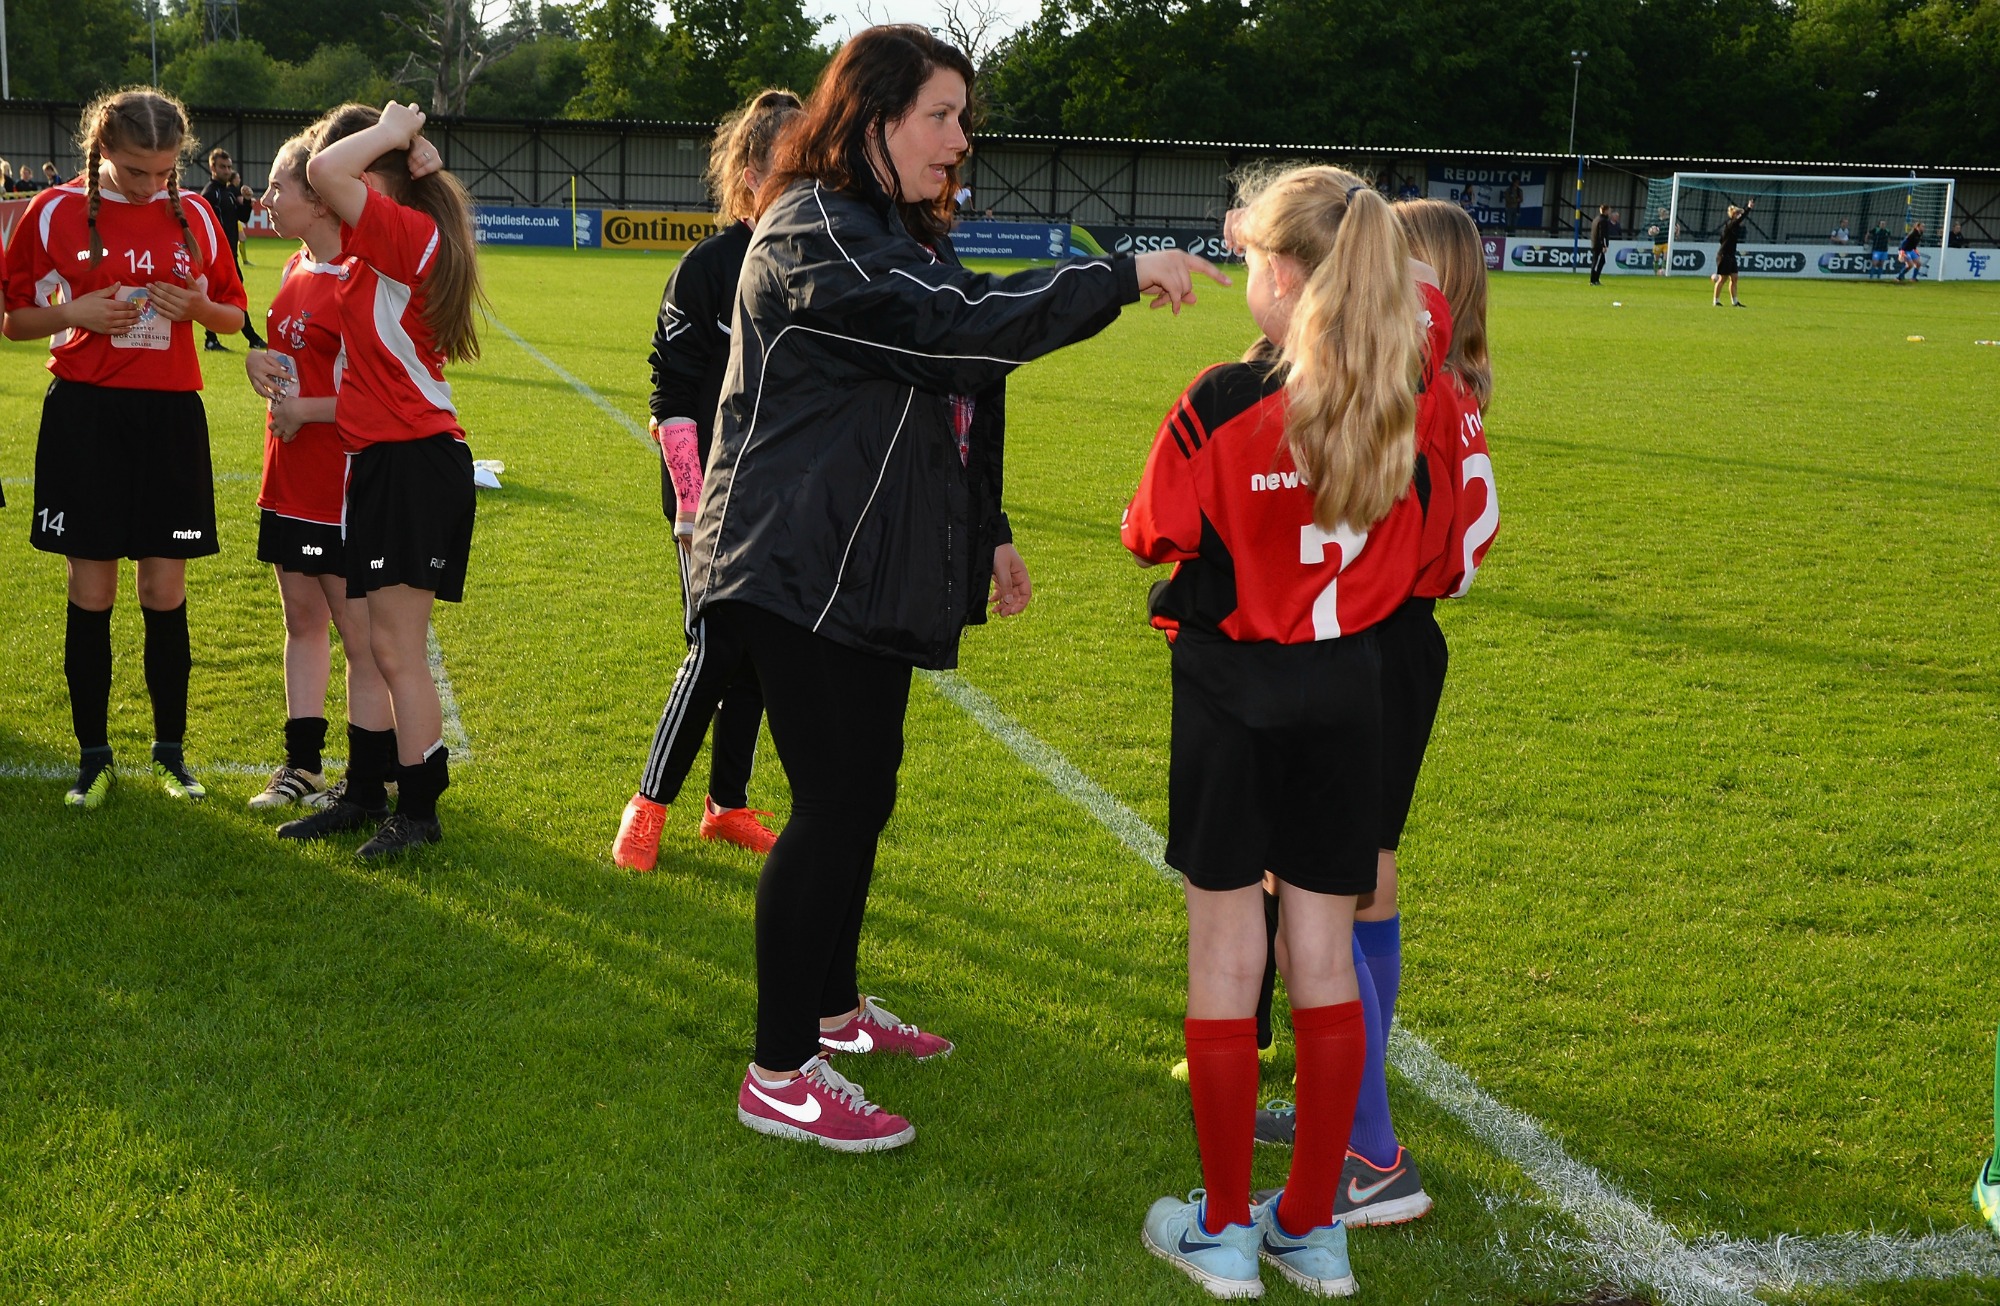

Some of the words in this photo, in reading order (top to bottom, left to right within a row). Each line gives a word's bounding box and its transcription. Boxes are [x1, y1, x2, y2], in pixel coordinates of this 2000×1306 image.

[1443, 167, 1532, 183] REDDITCH
[1135, 235, 1176, 254] sse
[123, 248, 155, 275] 14
[1521, 250, 1548, 263] BT
[1549, 248, 1593, 267] Sport
[1625, 252, 1652, 266] BT
[1754, 253, 1797, 271] Sport
[1827, 257, 1853, 270] BT
[1853, 256, 1896, 273] Sprt
[1251, 471, 1308, 492] new
[38, 507, 65, 536] 14
[172, 529, 202, 540] mitre
[1300, 523, 1368, 642] 7
